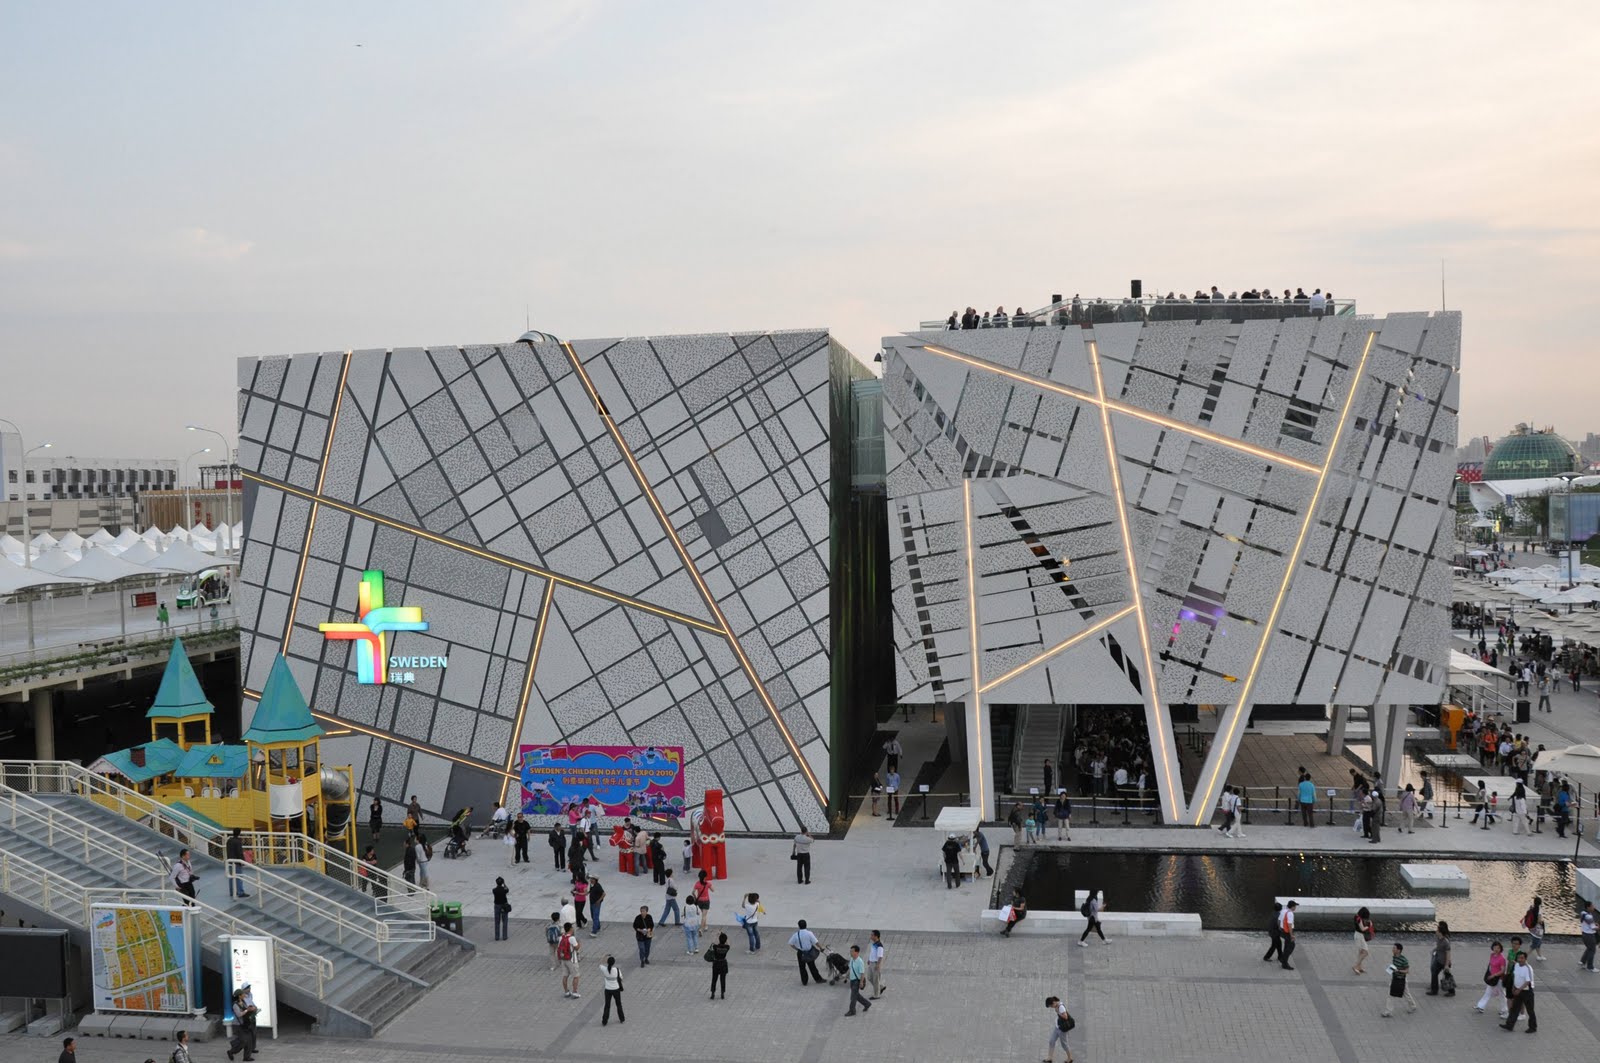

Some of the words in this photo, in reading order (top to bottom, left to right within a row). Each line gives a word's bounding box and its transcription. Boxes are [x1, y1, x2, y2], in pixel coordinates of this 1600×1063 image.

[389, 656, 448, 668] SWEDEN
[390, 672, 415, 684] 瑞典
[530, 767, 567, 775] SWEDEN'S
